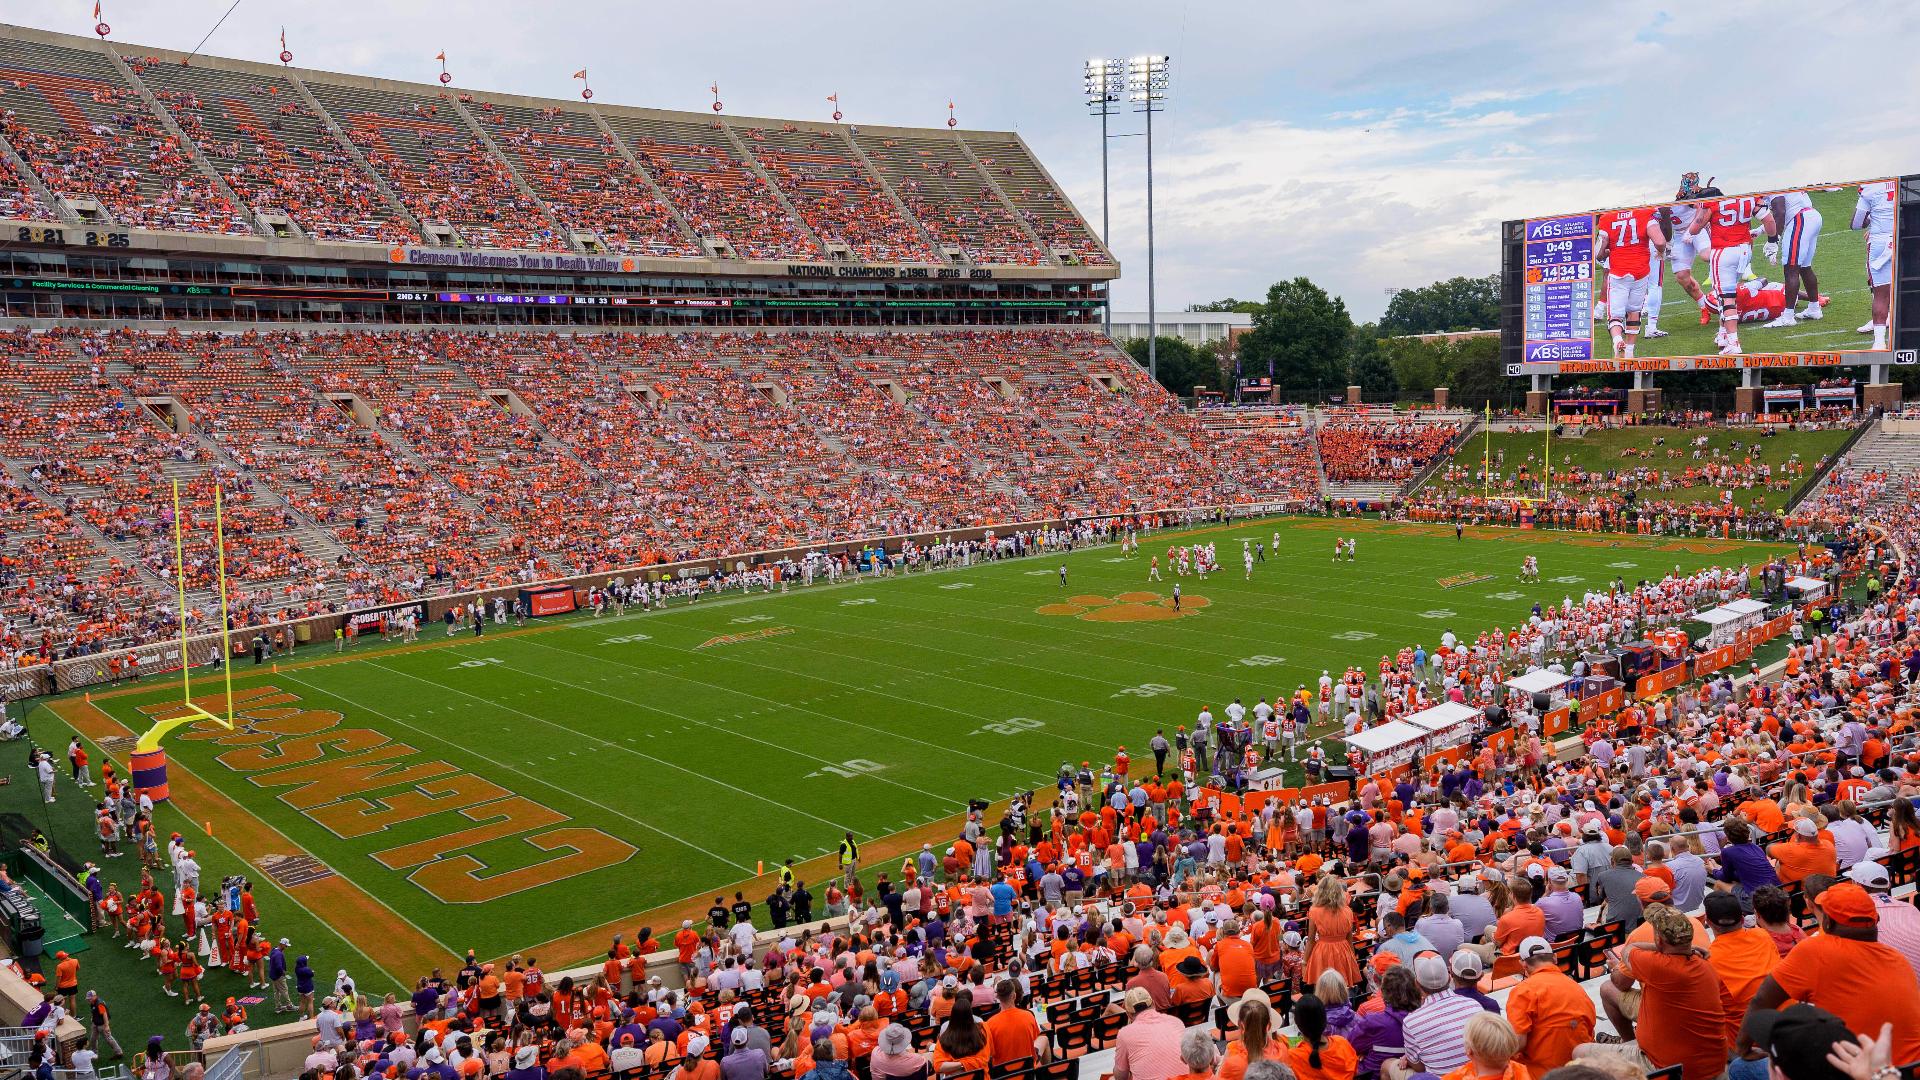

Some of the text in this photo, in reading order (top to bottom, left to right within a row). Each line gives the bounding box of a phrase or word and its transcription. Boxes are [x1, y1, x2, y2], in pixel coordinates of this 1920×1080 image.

[1611, 218, 1640, 247] 71
[1546, 241, 1573, 252] 0:49
[409, 250, 620, 273] Clemson Welcomes You to Death Valley
[787, 265, 837, 278] NATIONAL
[838, 266, 896, 279] CHAMPIONS
[937, 268, 961, 279] 2016
[969, 268, 992, 279] 2018
[1543, 267, 1558, 277] 14
[1560, 265, 1576, 276] 34
[32, 281, 56, 289] Facility
[91, 283, 131, 291] Commercial
[132, 285, 159, 293] Cleaning
[1897, 352, 1913, 363] 40
[1508, 365, 1520, 374] 40
[1559, 355, 1842, 373] MEMORIAL STADIUM FRANK HOWARD FIELD
[166, 649, 179, 660] CAT
[1756, 690, 1763, 699] 16
[133, 685, 641, 905] CLEMSN
[1079, 855, 1090, 866] 16
[937, 898, 948, 908] 16
